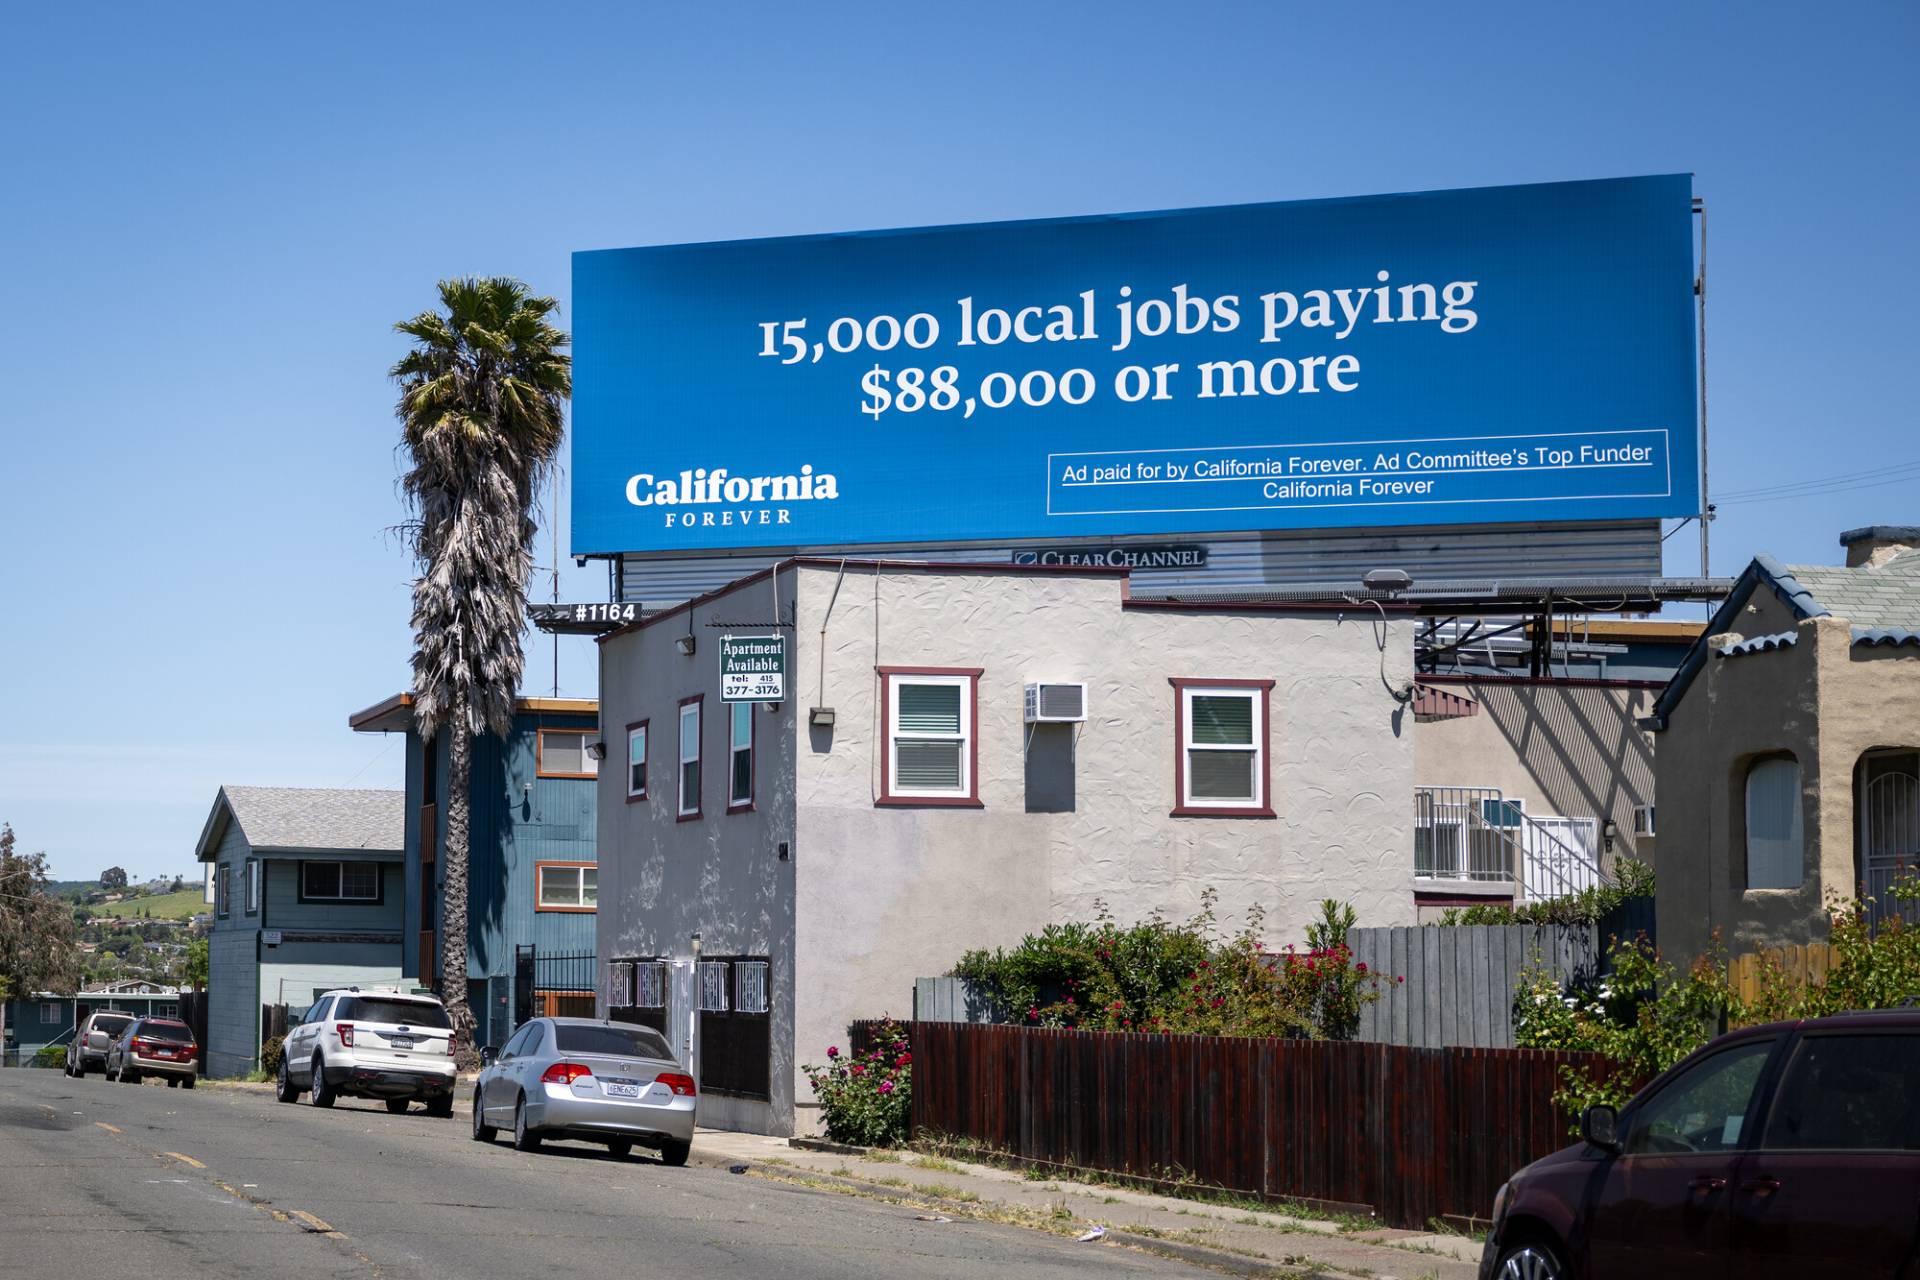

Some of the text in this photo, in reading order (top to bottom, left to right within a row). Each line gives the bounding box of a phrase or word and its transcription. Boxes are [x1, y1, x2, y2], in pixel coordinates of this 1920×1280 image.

[758, 270, 1478, 365] 15,000 local jobs paying
[861, 354, 1360, 421] $88,000 or more
[1062, 465, 1087, 482] Ad
[1091, 463, 1131, 484] paid
[1136, 462, 1162, 479] for
[1166, 462, 1190, 481] by
[1194, 457, 1282, 477] California
[1289, 456, 1367, 473] Forever.
[1373, 453, 1400, 471] Ad
[1534, 447, 1574, 468] Top
[1580, 444, 1652, 463] Funder
[625, 463, 839, 507] California
[1263, 478, 1435, 499] California Forever
[665, 509, 791, 528] FOREVER
[576, 604, 635, 621] #1164
[723, 642, 782, 658] Apartment
[726, 657, 779, 672] Available
[732, 674, 749, 683] tel:
[726, 685, 780, 695] 377-3176
